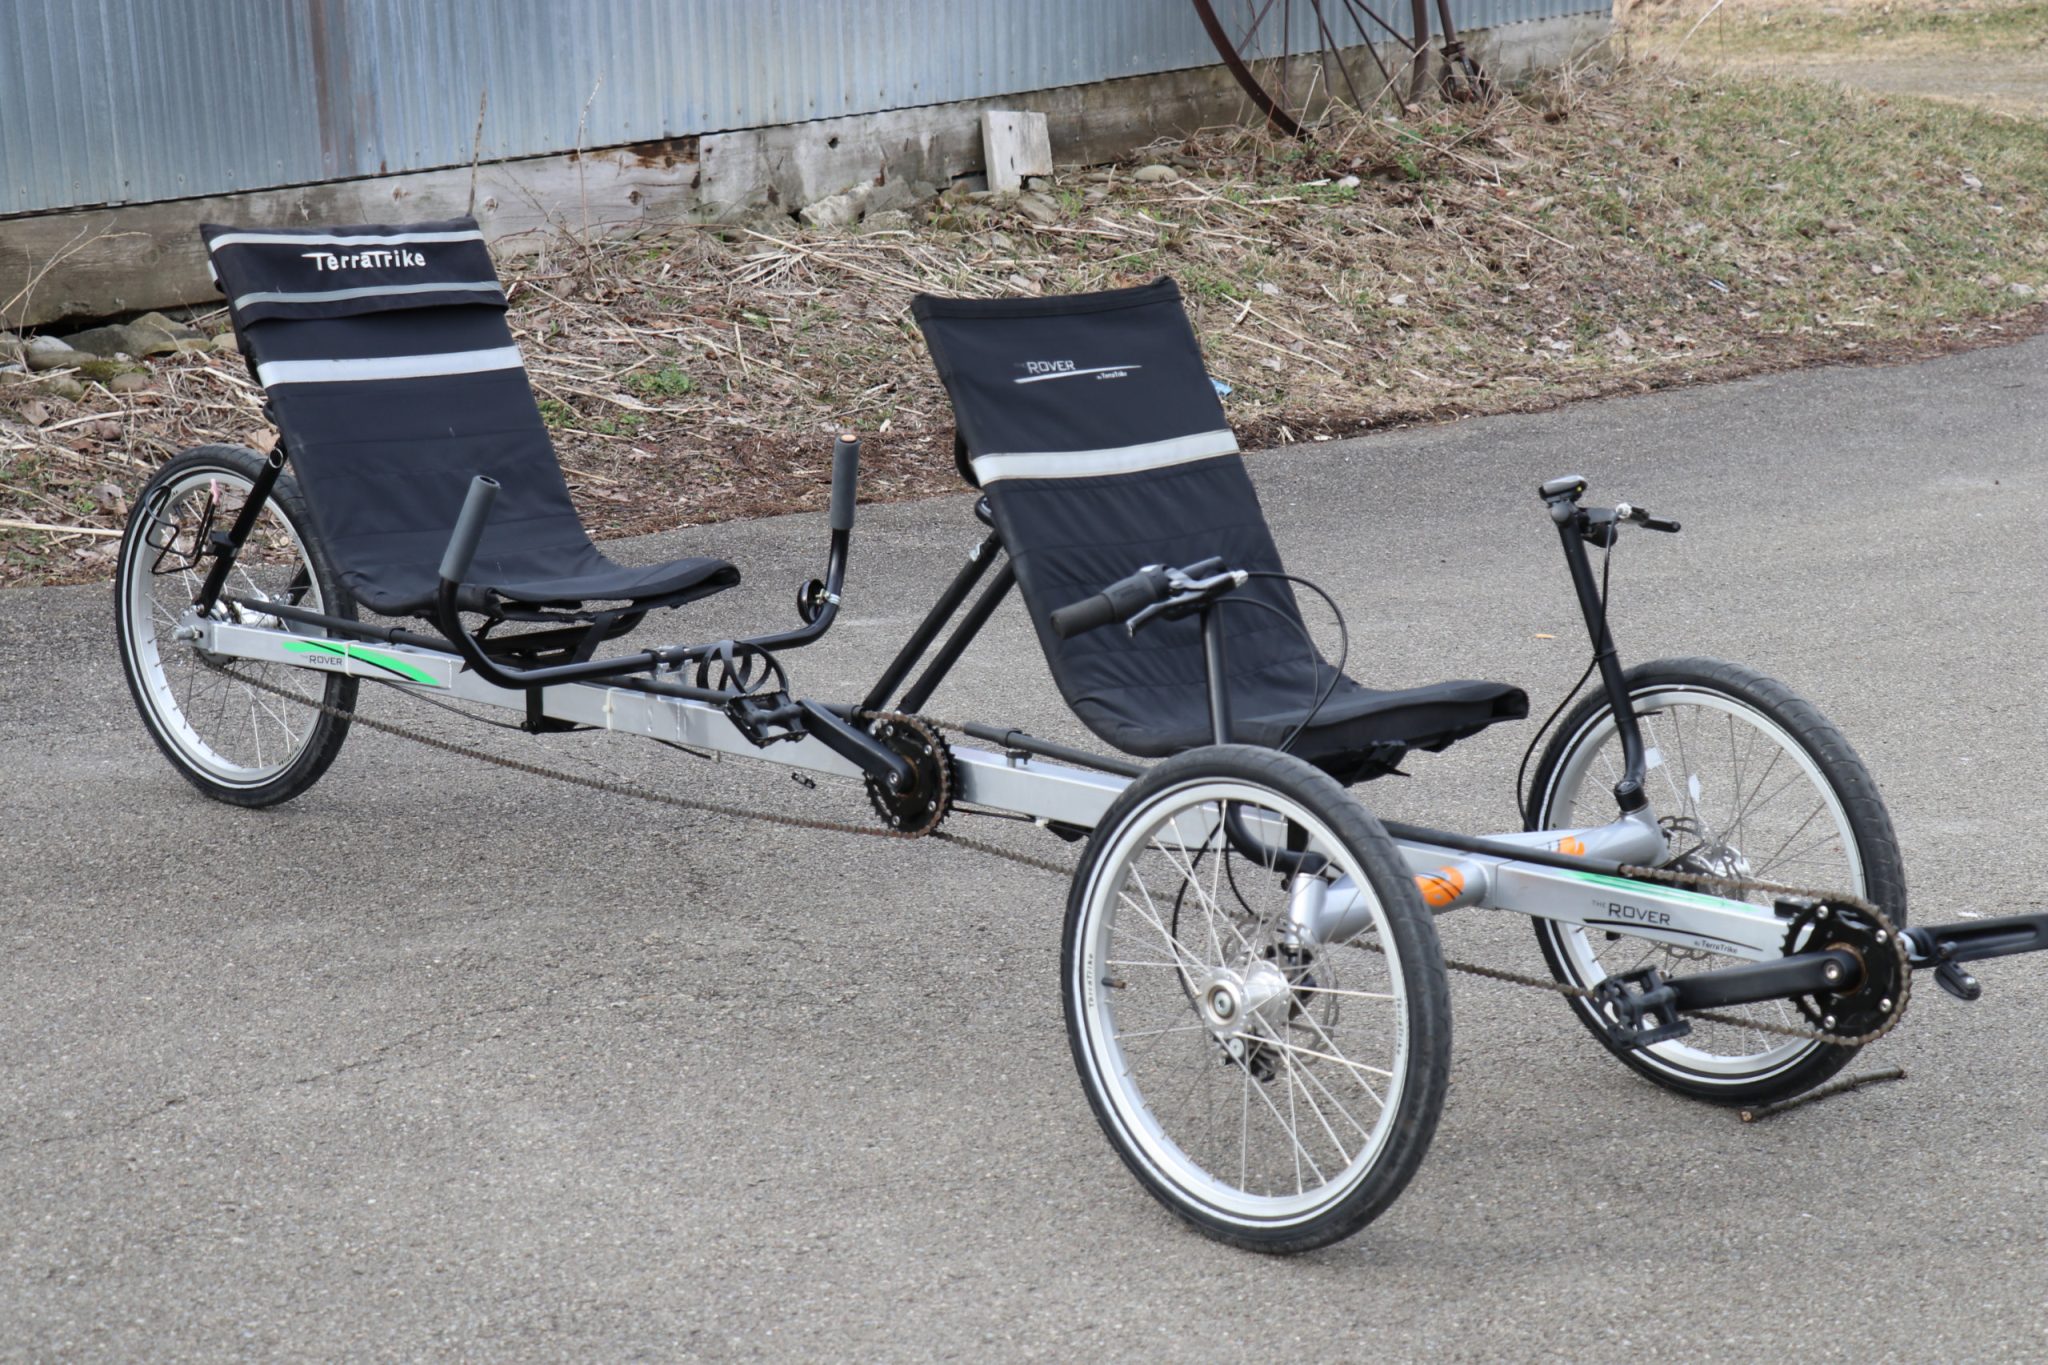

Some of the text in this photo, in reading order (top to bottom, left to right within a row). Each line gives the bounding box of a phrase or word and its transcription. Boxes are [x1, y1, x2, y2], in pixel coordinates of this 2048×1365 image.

[302, 250, 426, 271] TerraTrike
[1026, 360, 1076, 375] ROVER
[309, 654, 343, 667] ROVER
[1608, 902, 1671, 926] ROVER
